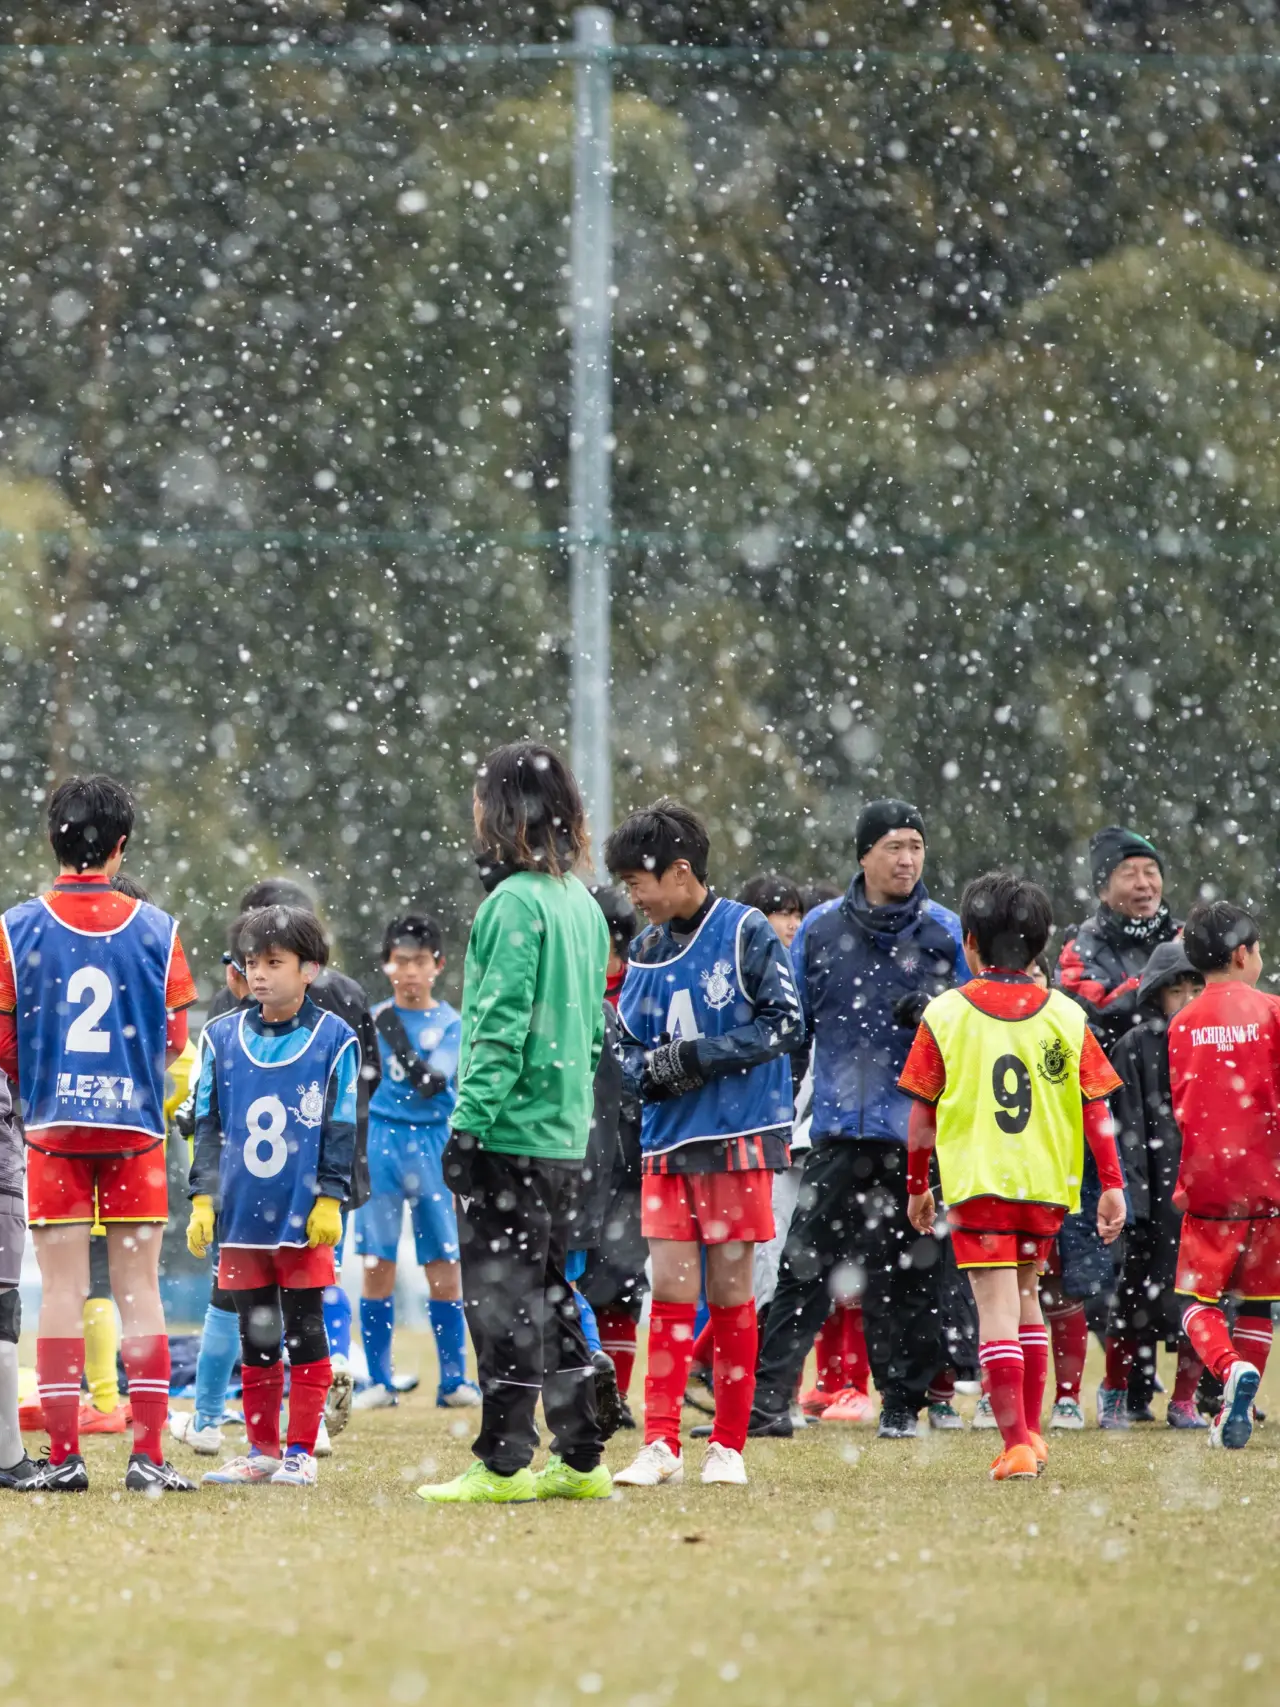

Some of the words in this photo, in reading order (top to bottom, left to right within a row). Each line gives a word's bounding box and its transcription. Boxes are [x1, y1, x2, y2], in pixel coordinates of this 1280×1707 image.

[66, 966, 112, 1053] 2
[666, 988, 705, 1041] 4
[1191, 1025, 1246, 1047] TACHIBANA
[1247, 1023, 1260, 1042] FC
[1216, 1042, 1235, 1053] 30th
[992, 1053, 1032, 1134] 9
[243, 1095, 288, 1178] 8
